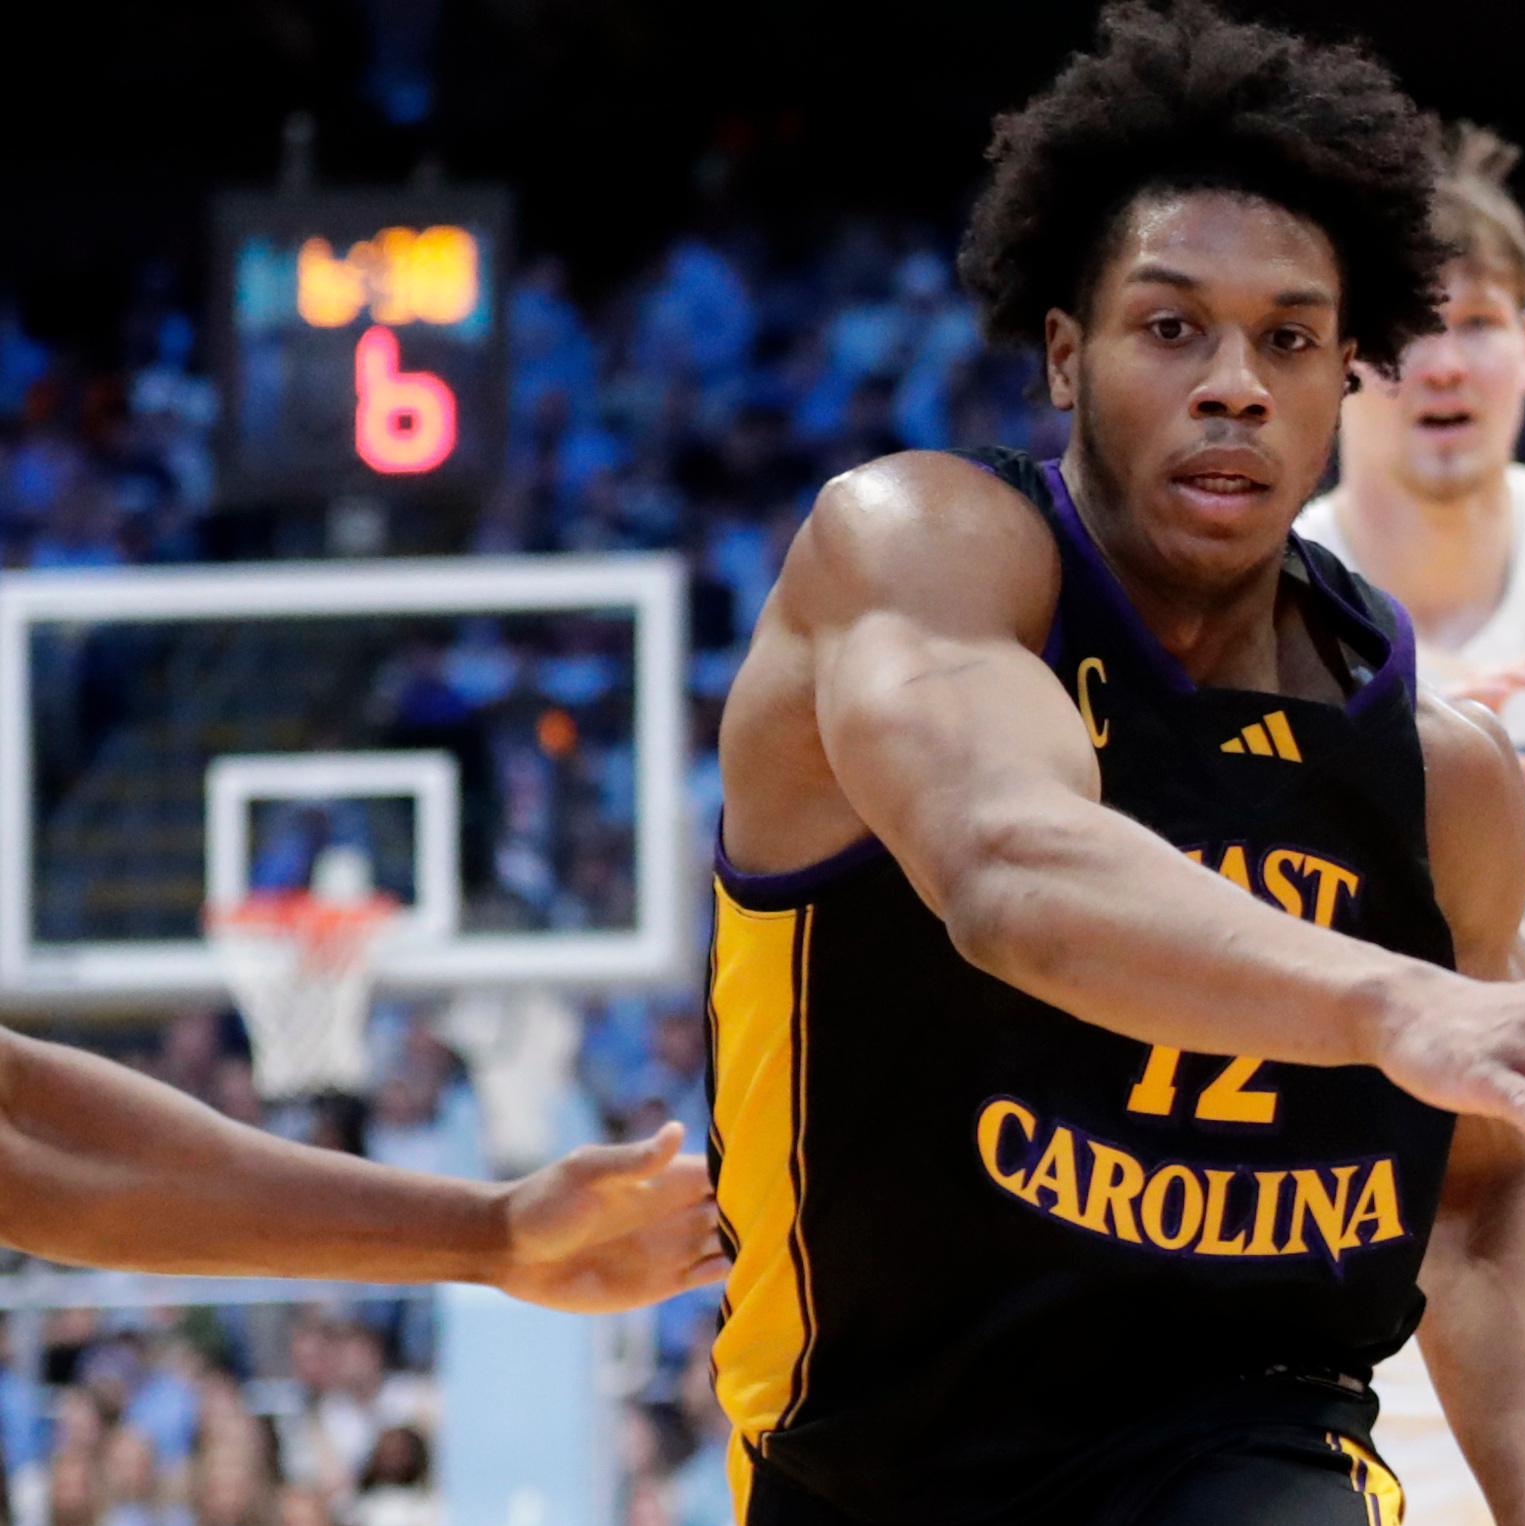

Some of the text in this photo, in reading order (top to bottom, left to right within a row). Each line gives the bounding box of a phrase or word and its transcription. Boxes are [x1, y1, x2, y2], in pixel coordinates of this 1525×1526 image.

[356, 326, 458, 473] 6
[1076, 656, 1109, 749] C
[976, 1099, 1407, 1264] CAROLINA
